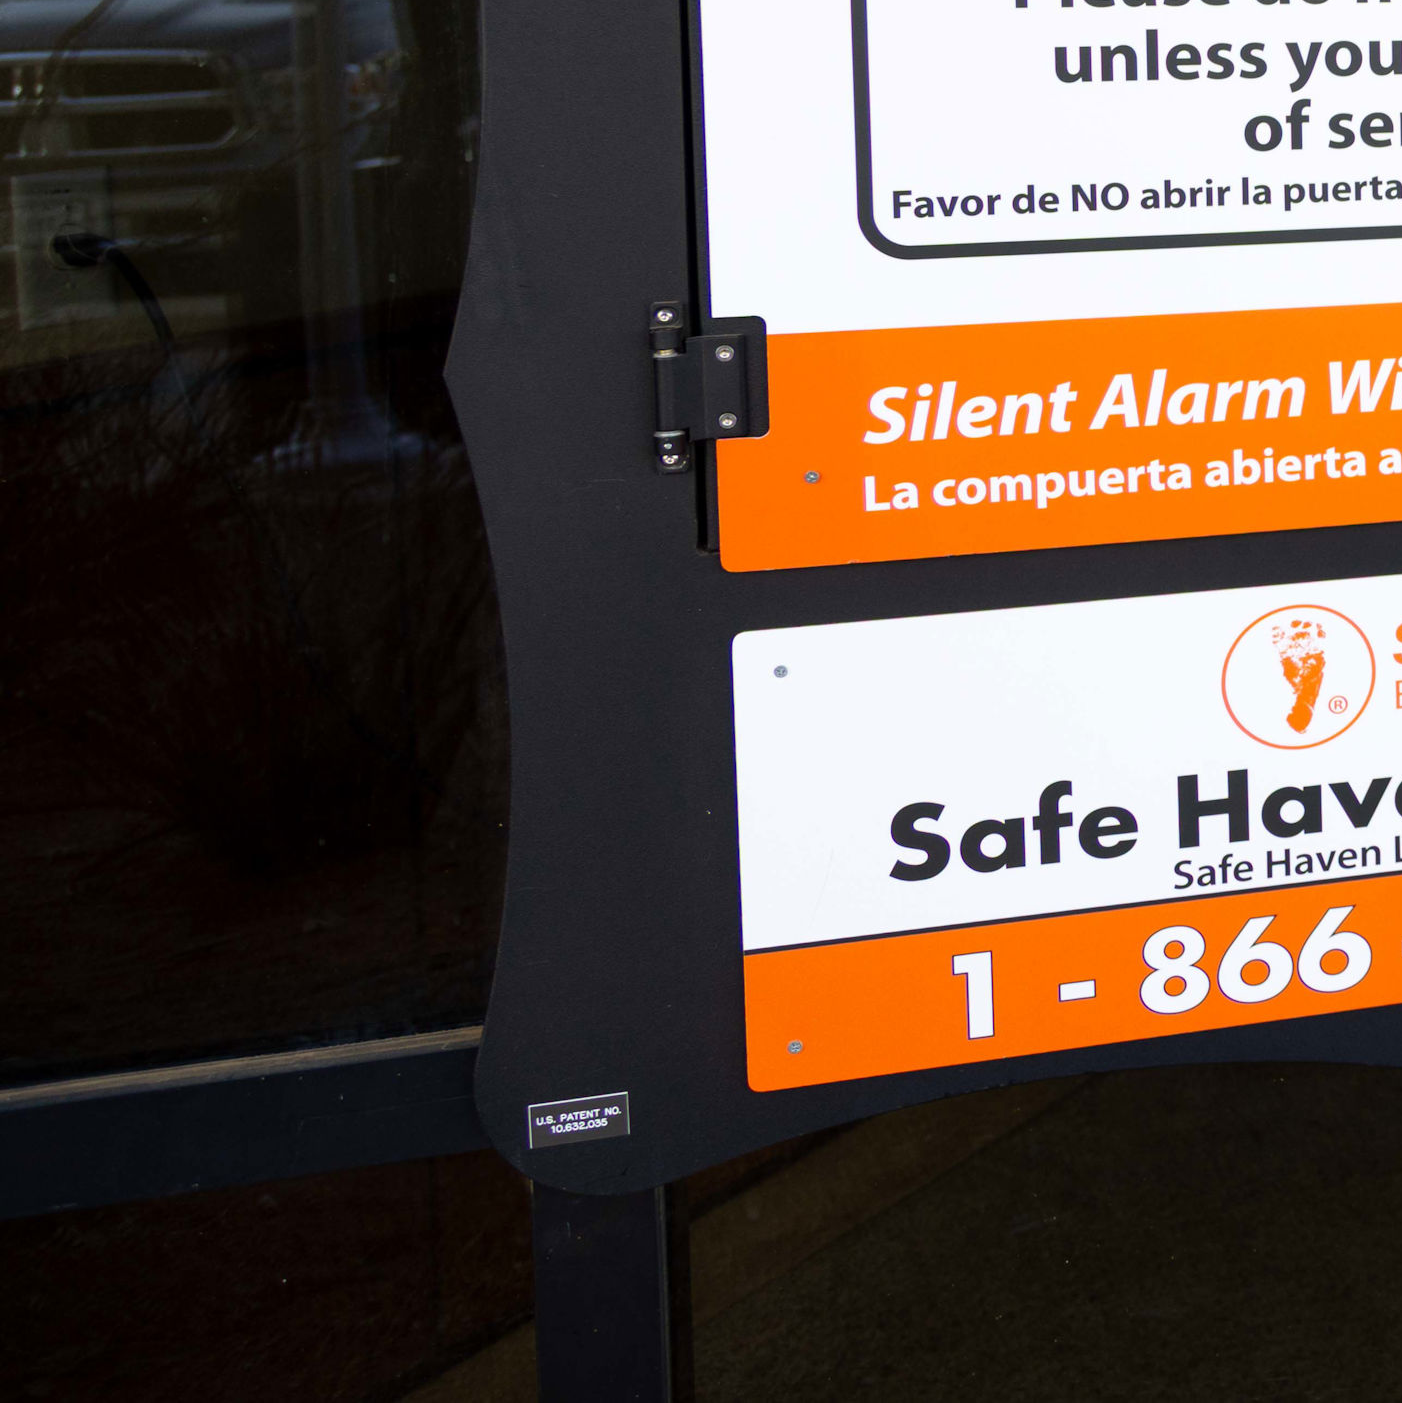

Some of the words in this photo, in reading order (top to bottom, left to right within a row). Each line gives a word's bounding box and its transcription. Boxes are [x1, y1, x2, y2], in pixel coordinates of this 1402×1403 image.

[1055, 29, 1267, 83] unless
[1286, 41, 1402, 92] you
[1245, 99, 1311, 151] of
[863, 381, 1078, 444] Silent
[1089, 369, 1305, 429] Alarm
[864, 476, 919, 511] La
[932, 460, 1191, 509] compuerta
[1205, 447, 1366, 487] abierta
[890, 781, 1138, 881] Safe
[1175, 854, 1253, 889] Safe
[1267, 846, 1380, 878] Haven
[952, 952, 993, 1038] 1
[1141, 906, 1371, 1014] 866
[536, 1115, 556, 1126] U.S.
[560, 1108, 600, 1122] PATENT
[604, 1106, 622, 1116] NO.
